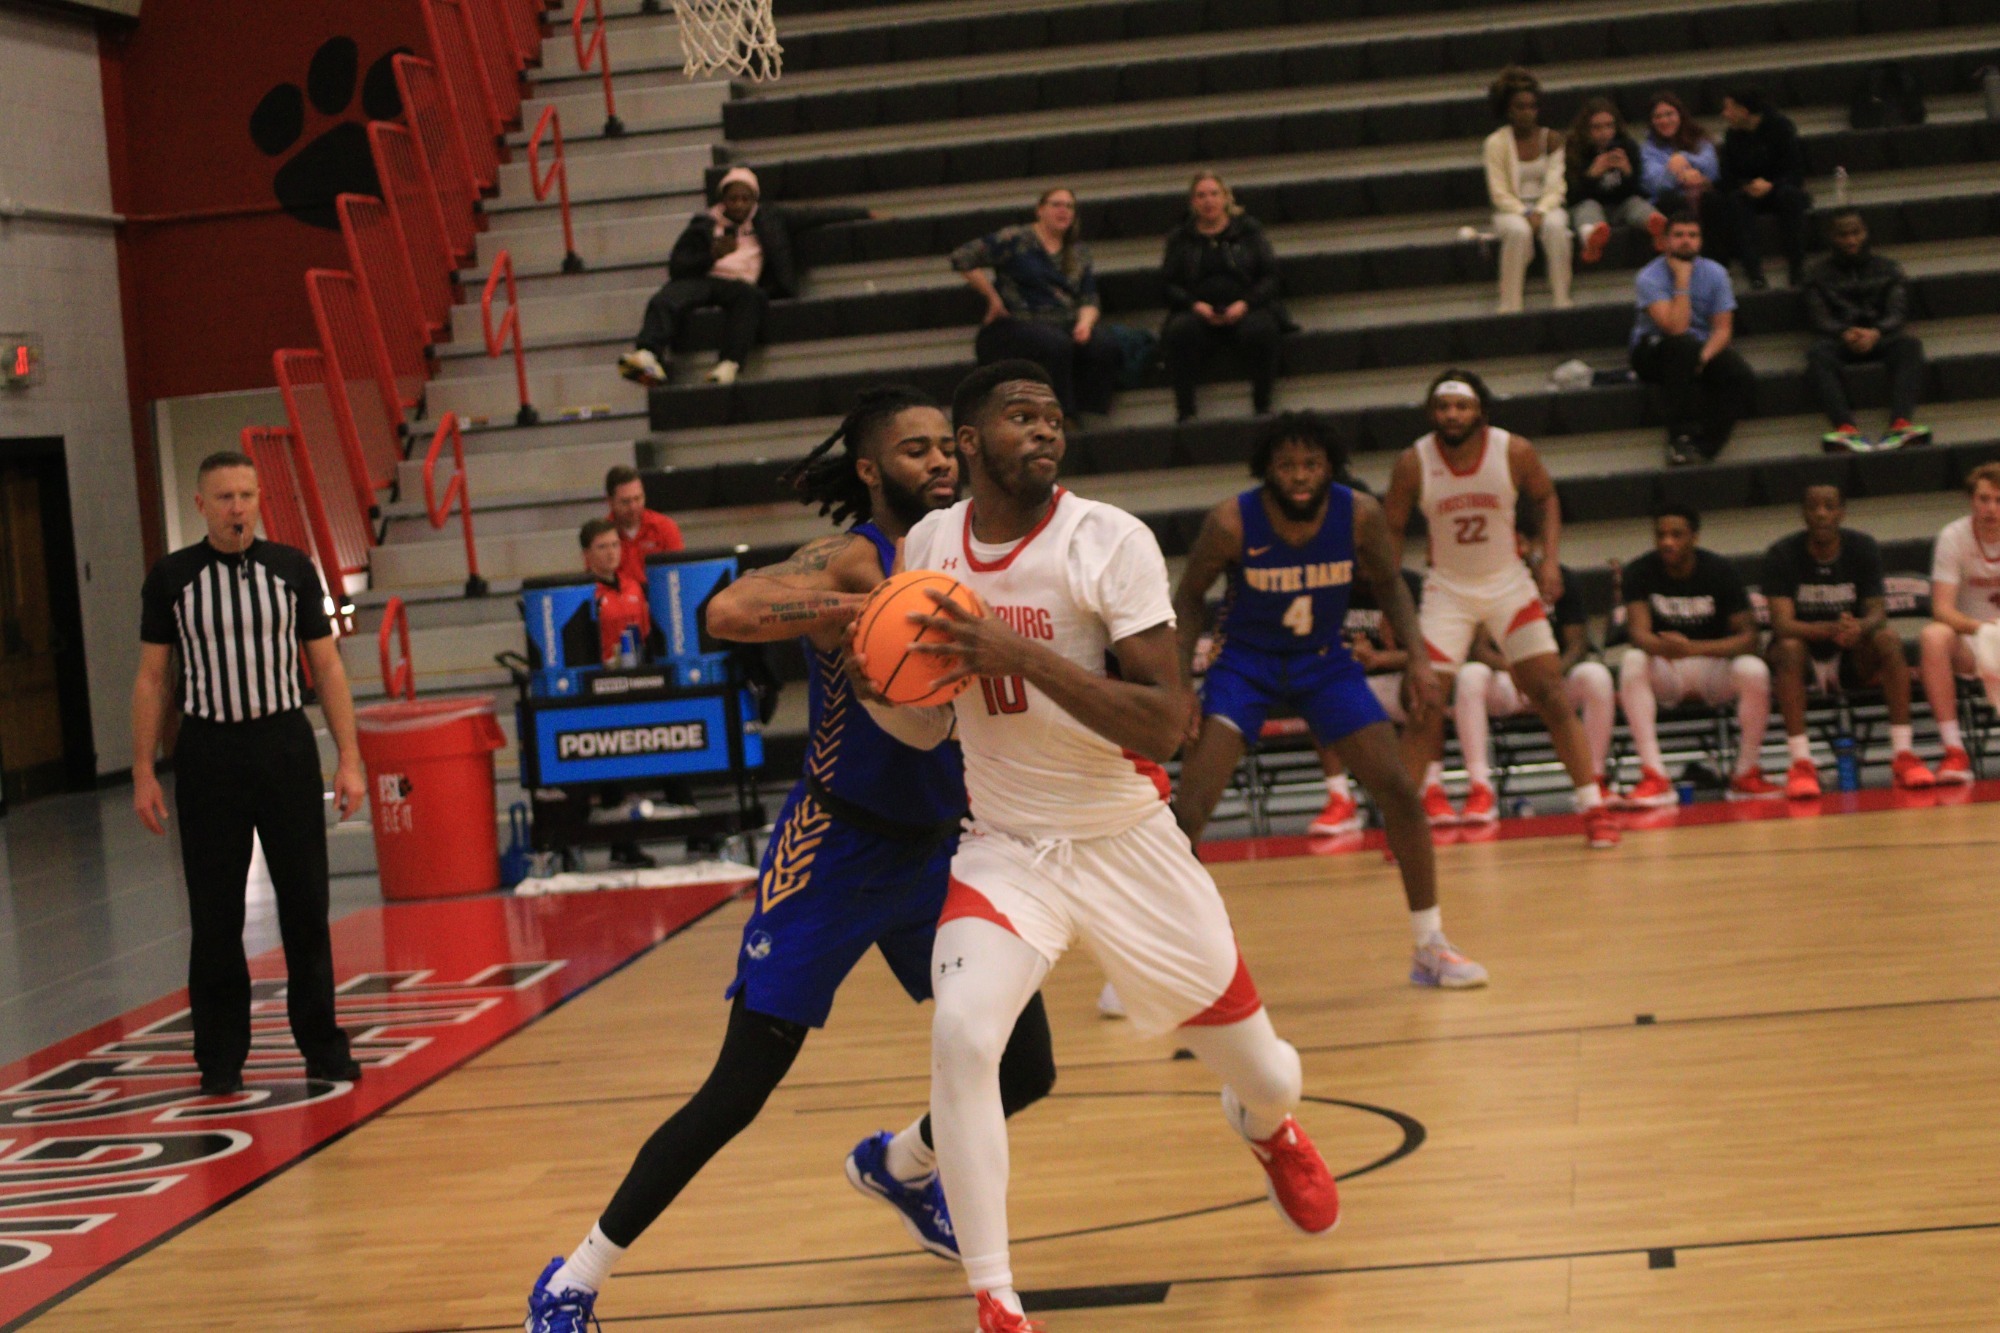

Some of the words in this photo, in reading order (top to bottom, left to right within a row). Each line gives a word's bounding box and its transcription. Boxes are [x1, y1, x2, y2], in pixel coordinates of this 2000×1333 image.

[1454, 514, 1488, 544] 22
[1282, 595, 1314, 636] 4
[980, 674, 1028, 716] 10
[559, 724, 704, 759] POWERADE
